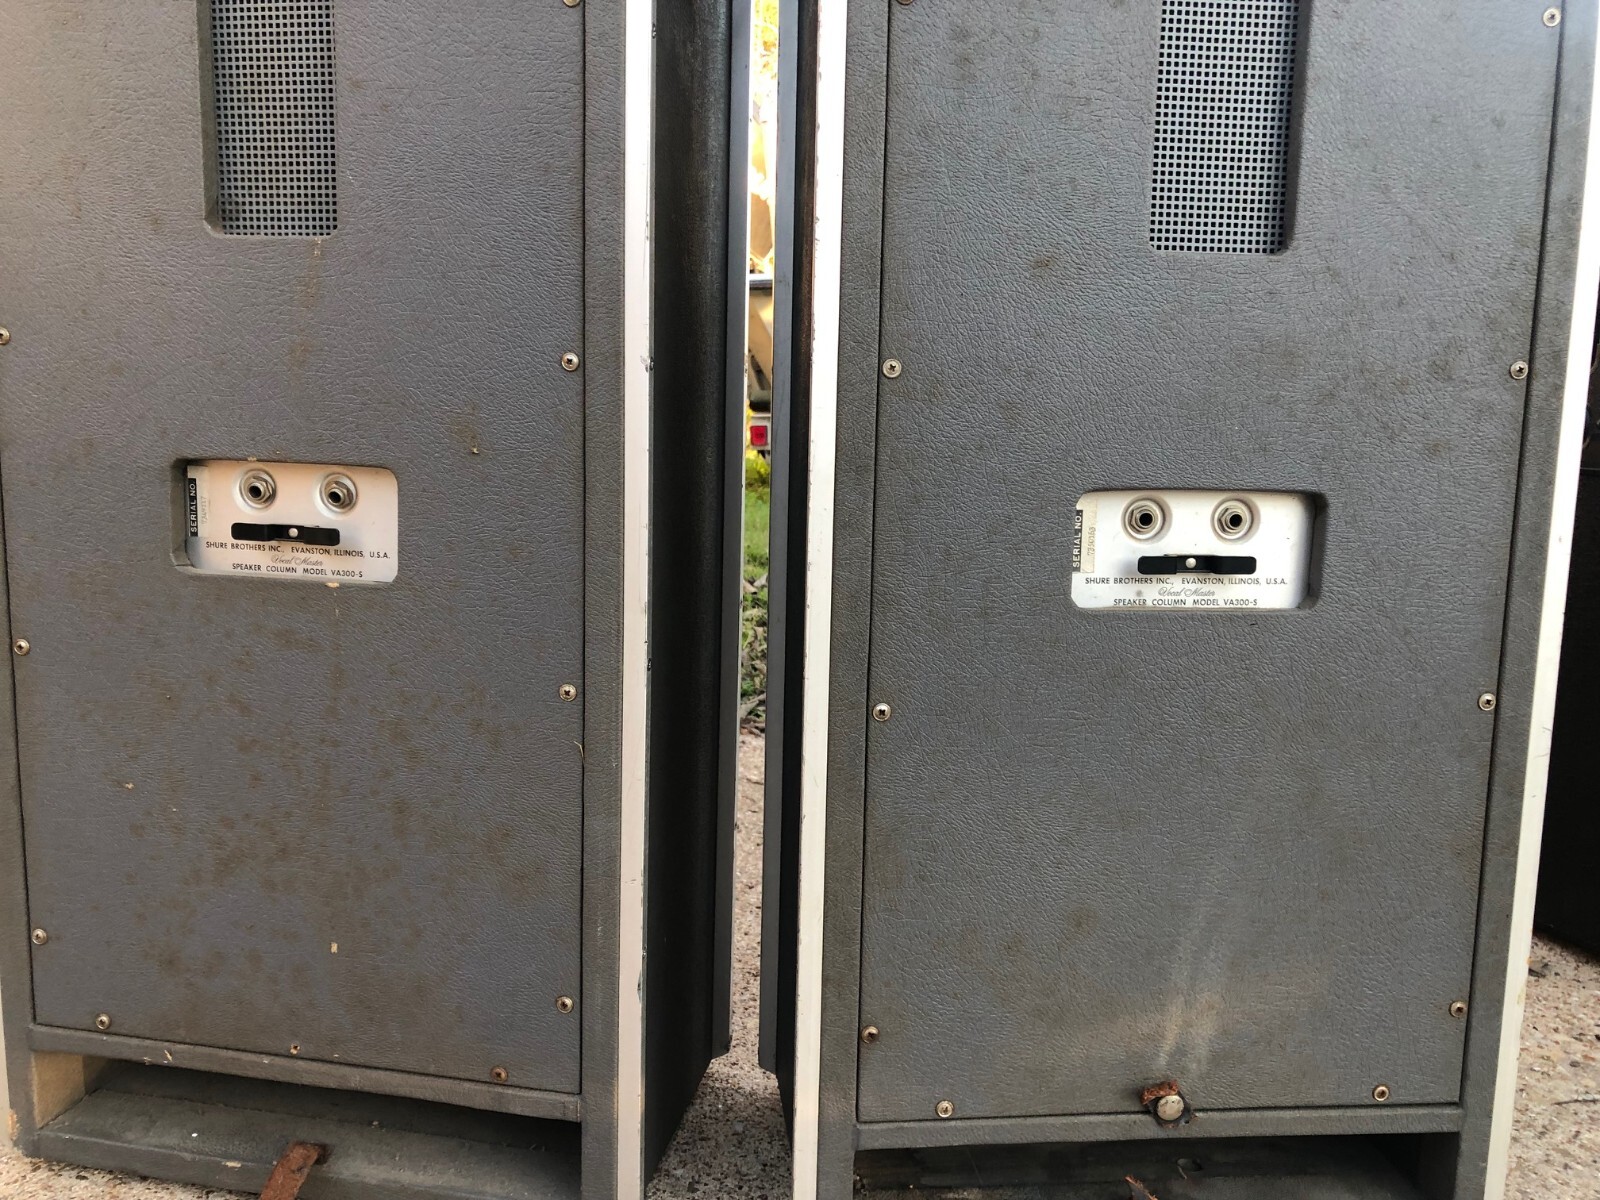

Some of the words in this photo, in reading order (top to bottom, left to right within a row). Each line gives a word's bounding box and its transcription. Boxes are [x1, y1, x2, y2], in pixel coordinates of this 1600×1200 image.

[1074, 511, 1083, 530] NO.
[205, 540, 228, 550] SHURE
[230, 542, 266, 552] BROTHERS
[291, 546, 332, 557] EVANSTON,
[333, 549, 365, 559] ILLINOIS,
[369, 551, 391, 560] U.S.A.
[1072, 531, 1082, 569] SERIAL
[270, 553, 294, 565] Vocal
[293, 556, 324, 567] Master
[231, 562, 262, 572] SPEAKER
[265, 565, 298, 574] COLUMN
[302, 567, 328, 576] MODEL
[330, 569, 363, 578] VA300-S
[1084, 577, 1111, 585] SHURE
[1113, 577, 1154, 585] BROTHERS
[1181, 577, 1227, 587] EVANSTON,
[1227, 577, 1262, 587] ILLINOIS,
[1265, 577, 1289, 586] U.S.A.
[1157, 586, 1186, 598] Vocal
[1183, 587, 1216, 598] Master
[1113, 598, 1148, 607] SPEAKER
[1151, 598, 1187, 607] COLUMN
[1192, 598, 1220, 607] MODEL
[1223, 598, 1258, 607] VA300-S
